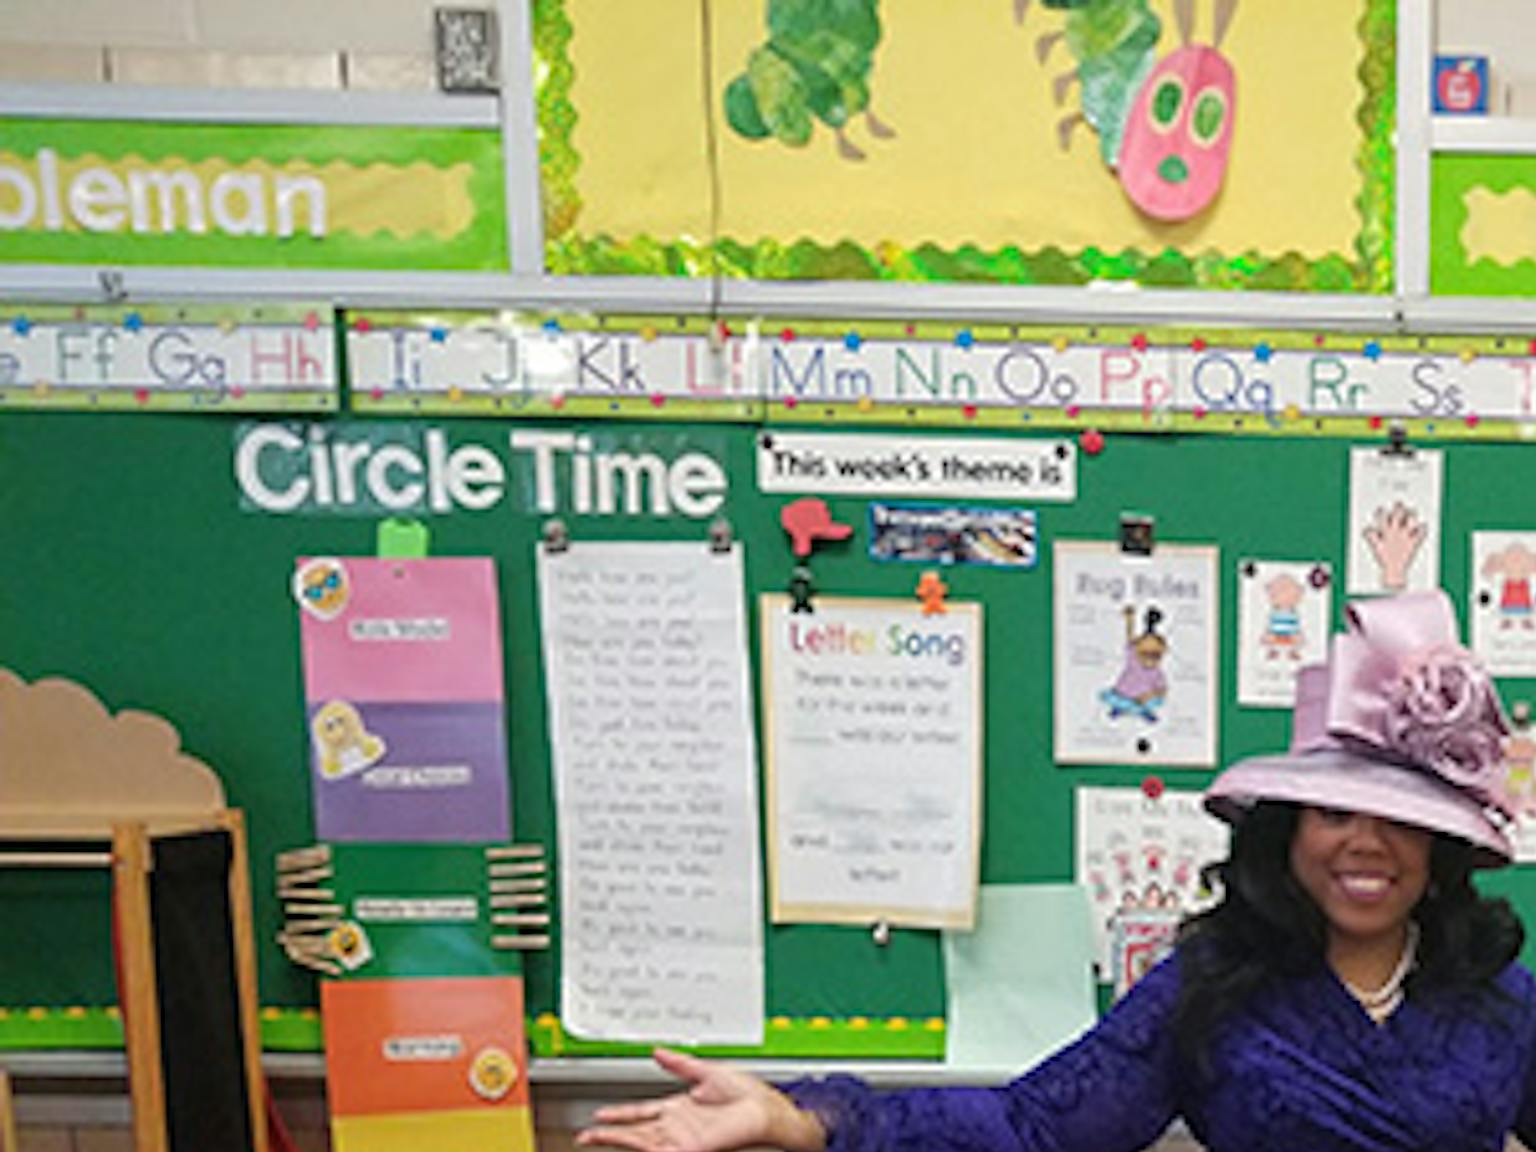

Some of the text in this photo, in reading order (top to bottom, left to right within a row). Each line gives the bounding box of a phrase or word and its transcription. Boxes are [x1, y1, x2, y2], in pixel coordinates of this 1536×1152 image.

[57, 333, 115, 383] Ff
[148, 334, 226, 403] Gg
[250, 334, 323, 381] Hh
[576, 336, 647, 392] Kk
[772, 347, 872, 398] Mm
[896, 348, 976, 398] Nn
[996, 349, 1077, 404] Oo
[1100, 351, 1171, 421] Pp
[1193, 353, 1284, 428] Qq
[1309, 358, 1369, 411] Rr
[1411, 361, 1462, 416] Ss
[235, 426, 728, 516] Circle Time
[774, 451, 1062, 486] This week's theme is
[788, 621, 965, 666] Letter Song
